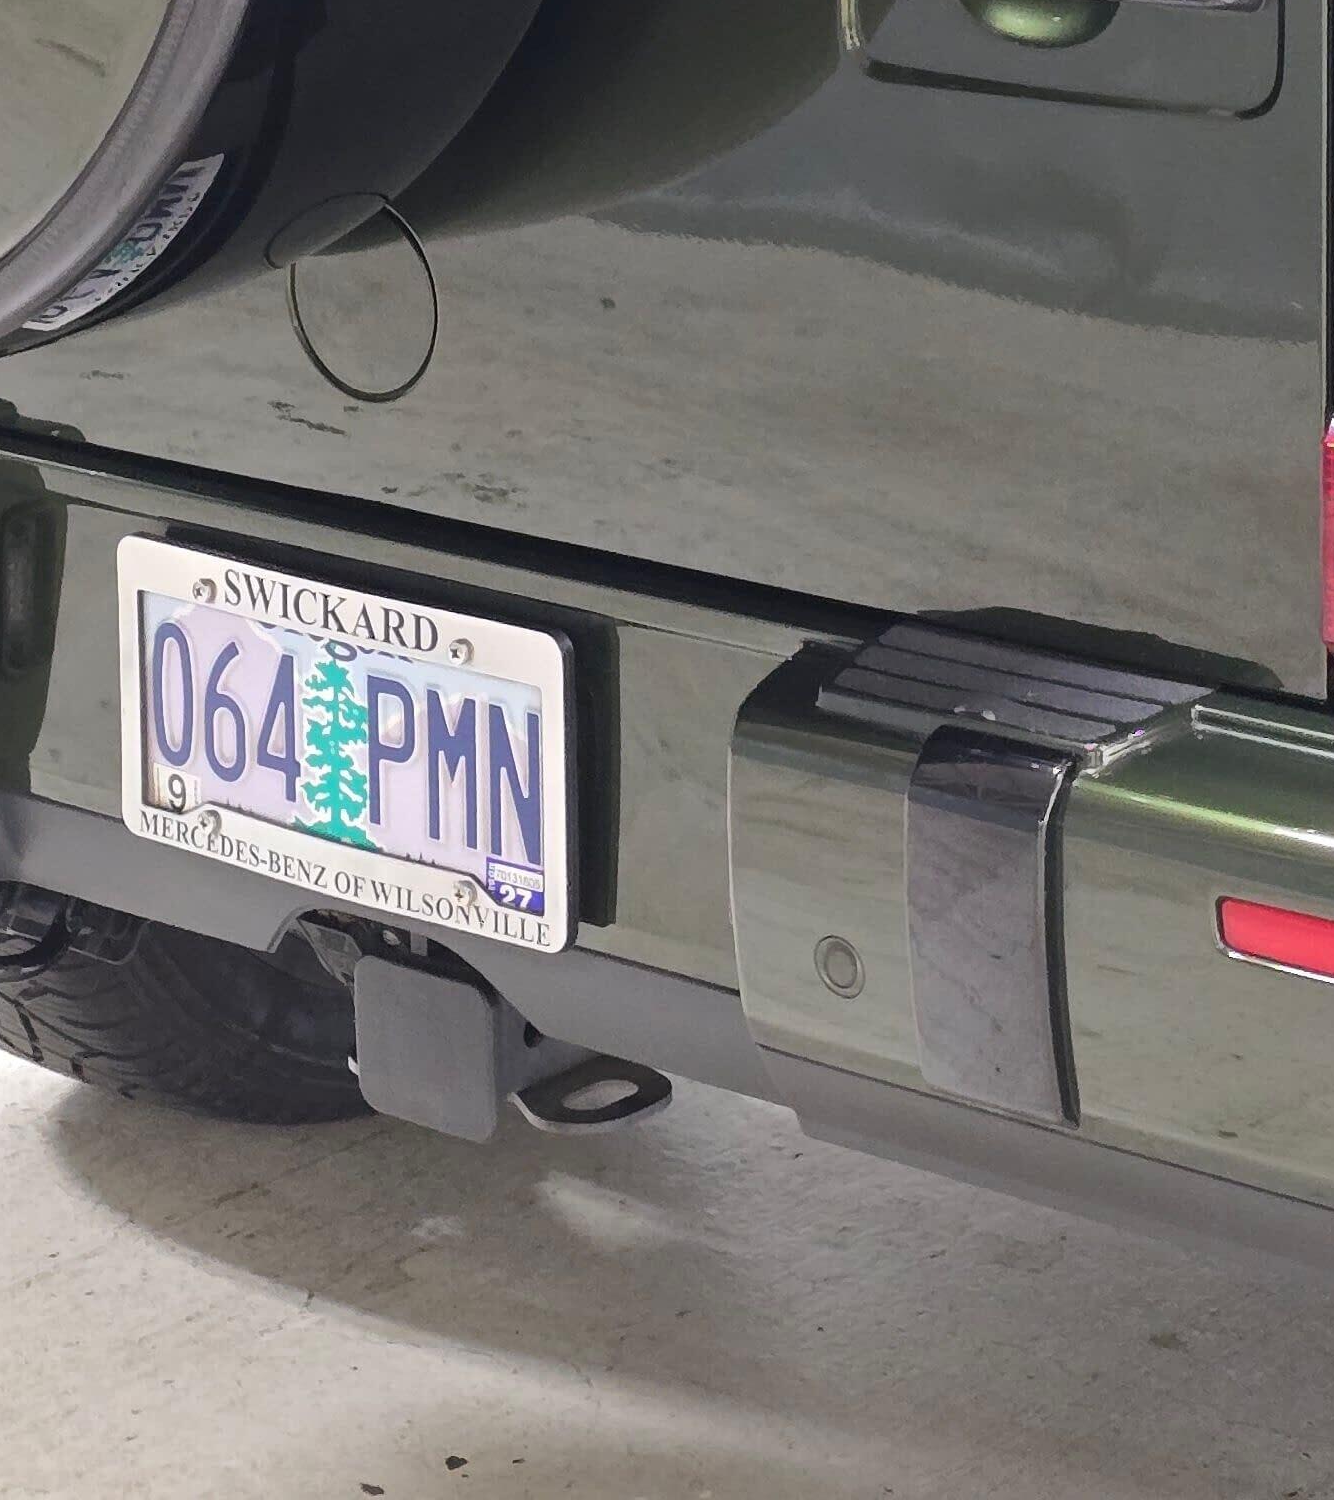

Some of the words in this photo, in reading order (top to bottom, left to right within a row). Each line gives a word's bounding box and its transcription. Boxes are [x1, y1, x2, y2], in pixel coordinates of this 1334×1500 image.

[224, 568, 439, 653] SWICKARD
[152, 622, 301, 802] 064
[367, 674, 541, 865] PMN
[167, 773, 188, 811] 9
[140, 809, 328, 887] MERCEDES-BENZ
[335, 871, 367, 900] OF
[370, 886, 551, 948] WILSONVILLE
[499, 884, 533, 909] 27
